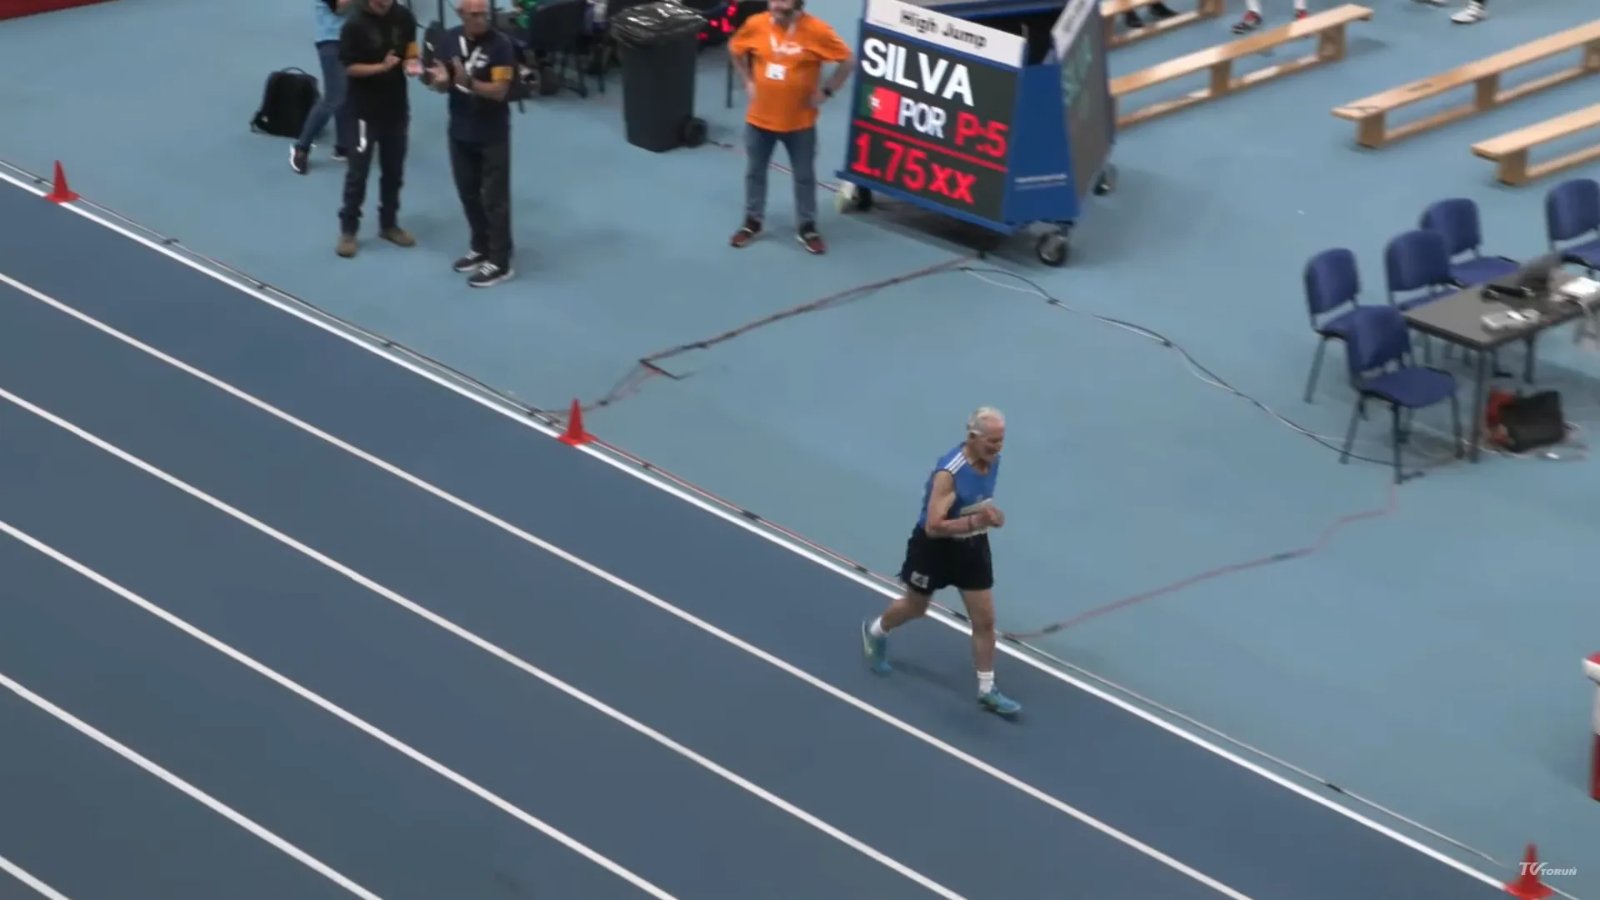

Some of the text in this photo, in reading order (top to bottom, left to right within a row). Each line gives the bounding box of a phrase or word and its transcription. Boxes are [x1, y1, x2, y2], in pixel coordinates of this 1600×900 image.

[901, 10, 987, 49] High Jump
[861, 38, 974, 106] SILVA
[898, 97, 946, 138] POR
